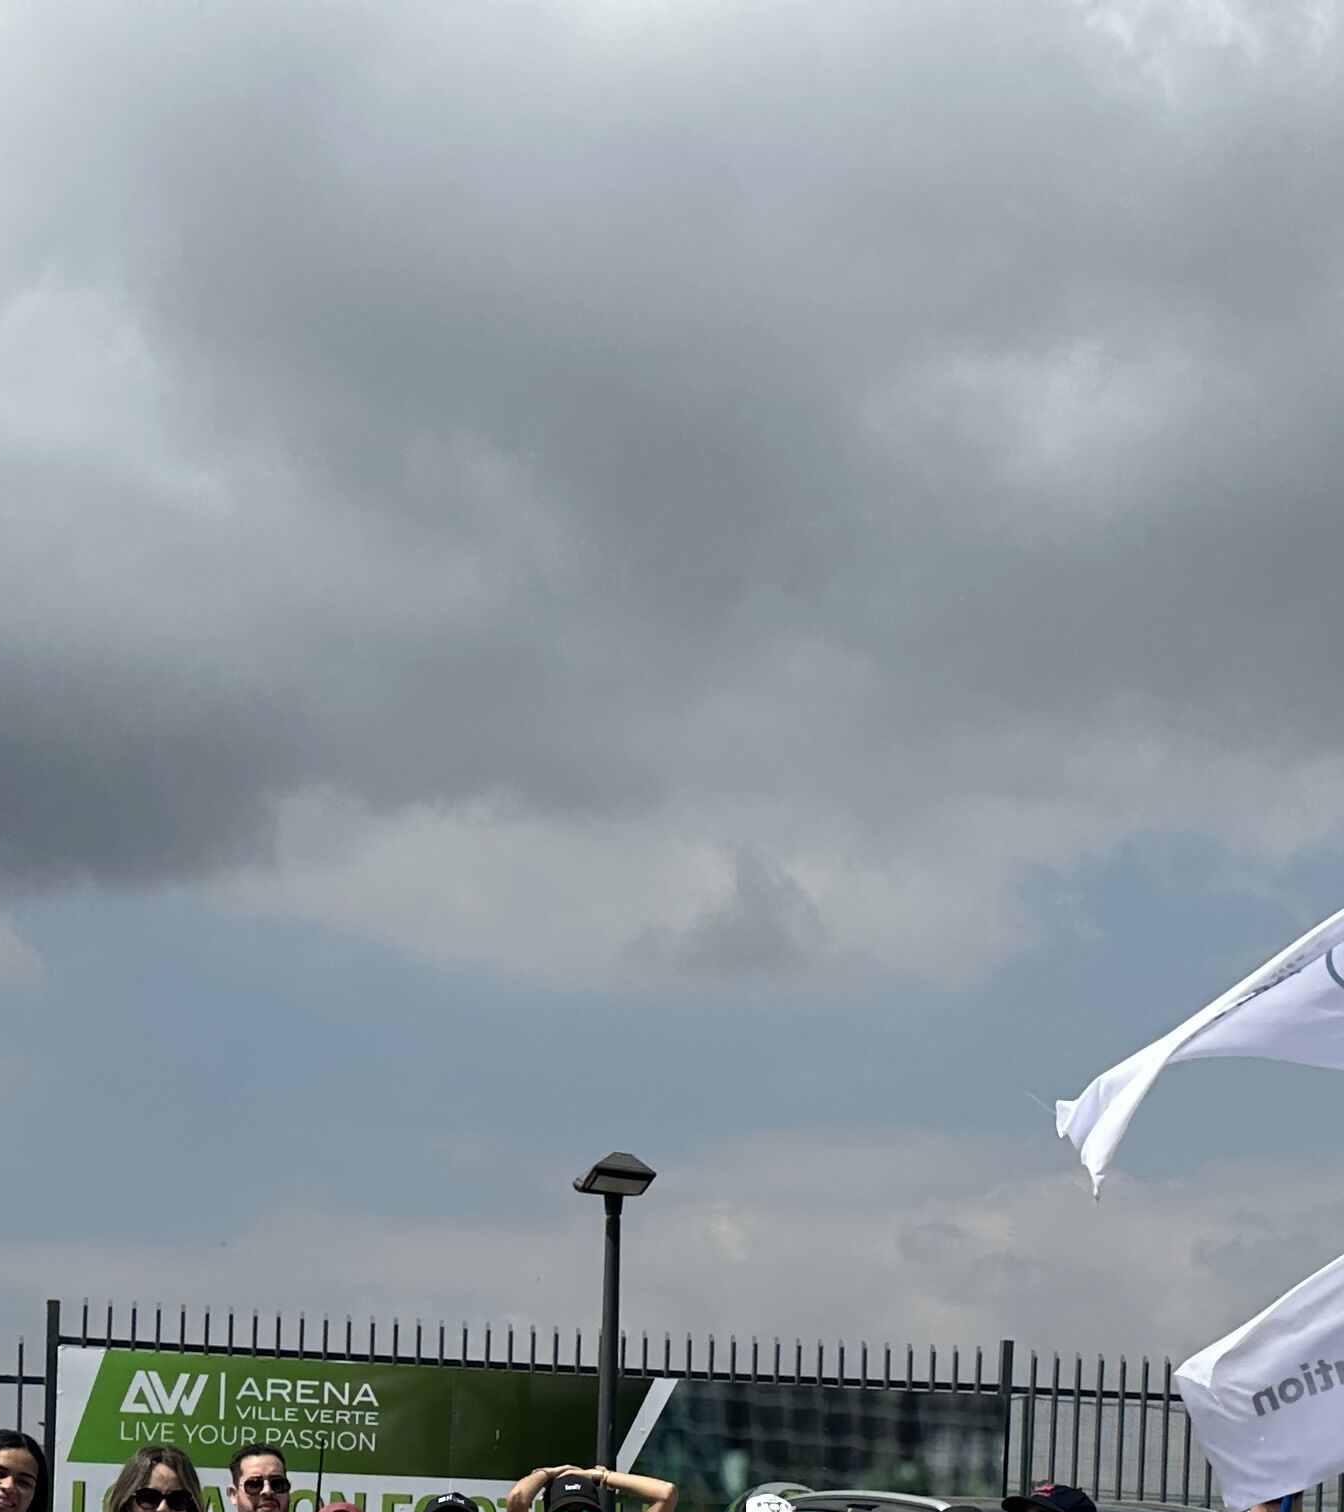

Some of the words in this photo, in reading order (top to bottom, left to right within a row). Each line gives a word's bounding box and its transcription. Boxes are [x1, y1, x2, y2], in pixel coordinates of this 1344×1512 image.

[236, 1376, 379, 1407] ARENA
[236, 1405, 299, 1422] VILLE
[304, 1408, 379, 1426] VERTE
[120, 1421, 175, 1443] LIVE
[182, 1422, 256, 1447] YOUR
[266, 1428, 376, 1452] PASSION
